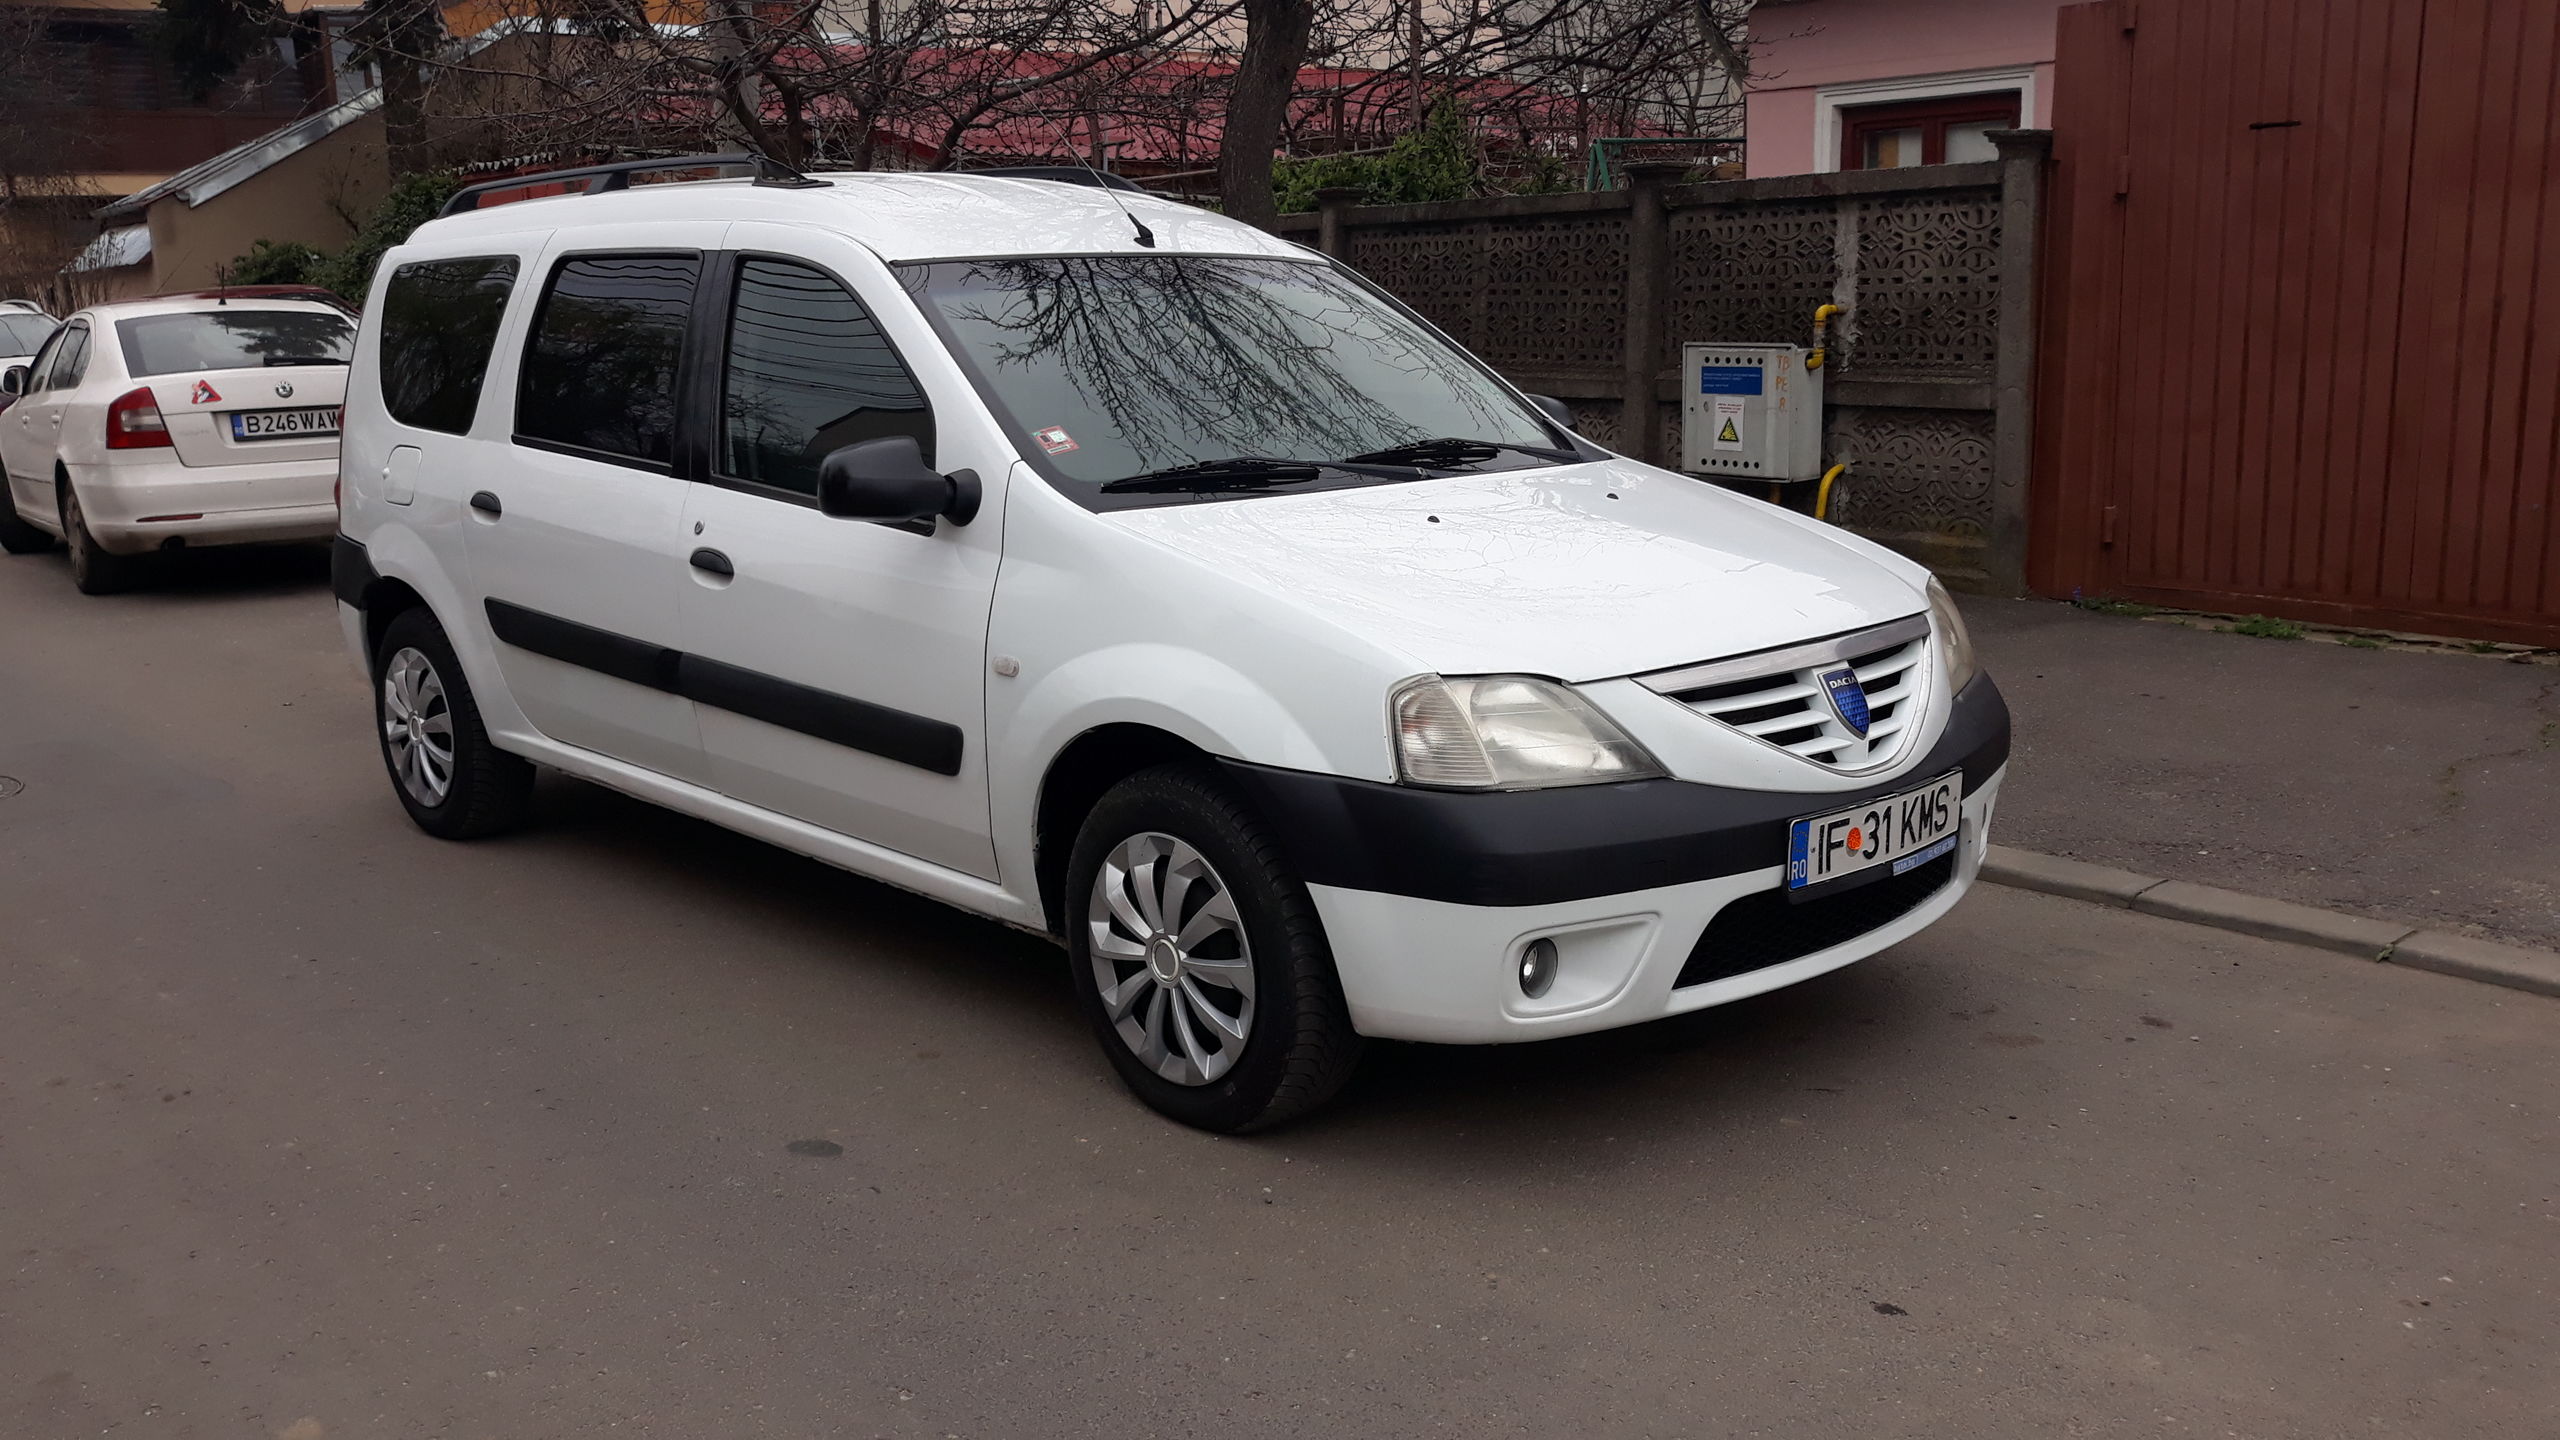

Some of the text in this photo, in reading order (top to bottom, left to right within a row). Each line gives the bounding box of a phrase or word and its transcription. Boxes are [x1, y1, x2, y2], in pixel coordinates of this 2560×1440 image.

[246, 415, 261, 433] B
[263, 413, 298, 433] 246
[1829, 676, 1858, 689] DACIA
[1818, 784, 1950, 875] IF 31 KMS
[1791, 858, 1807, 880] RO
